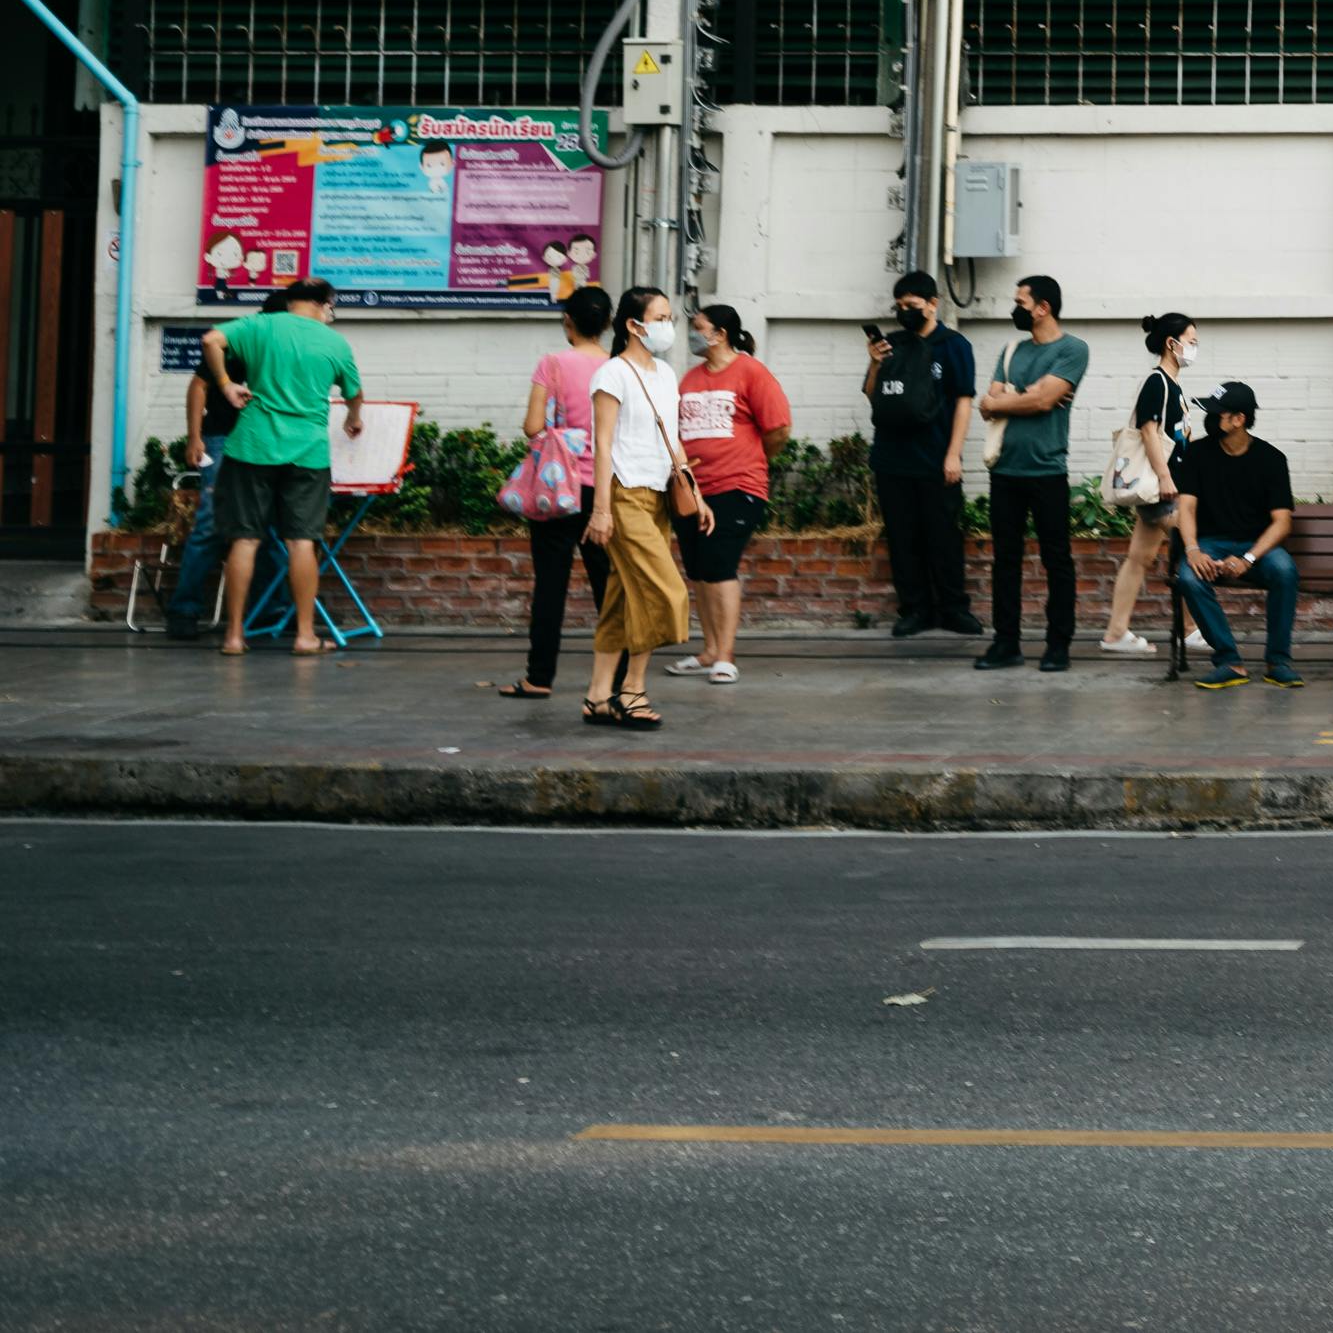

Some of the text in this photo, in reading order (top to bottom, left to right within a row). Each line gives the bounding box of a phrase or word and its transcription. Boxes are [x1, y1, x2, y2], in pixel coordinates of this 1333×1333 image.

[419, 115, 555, 139] รับสมัครนักเรียน
